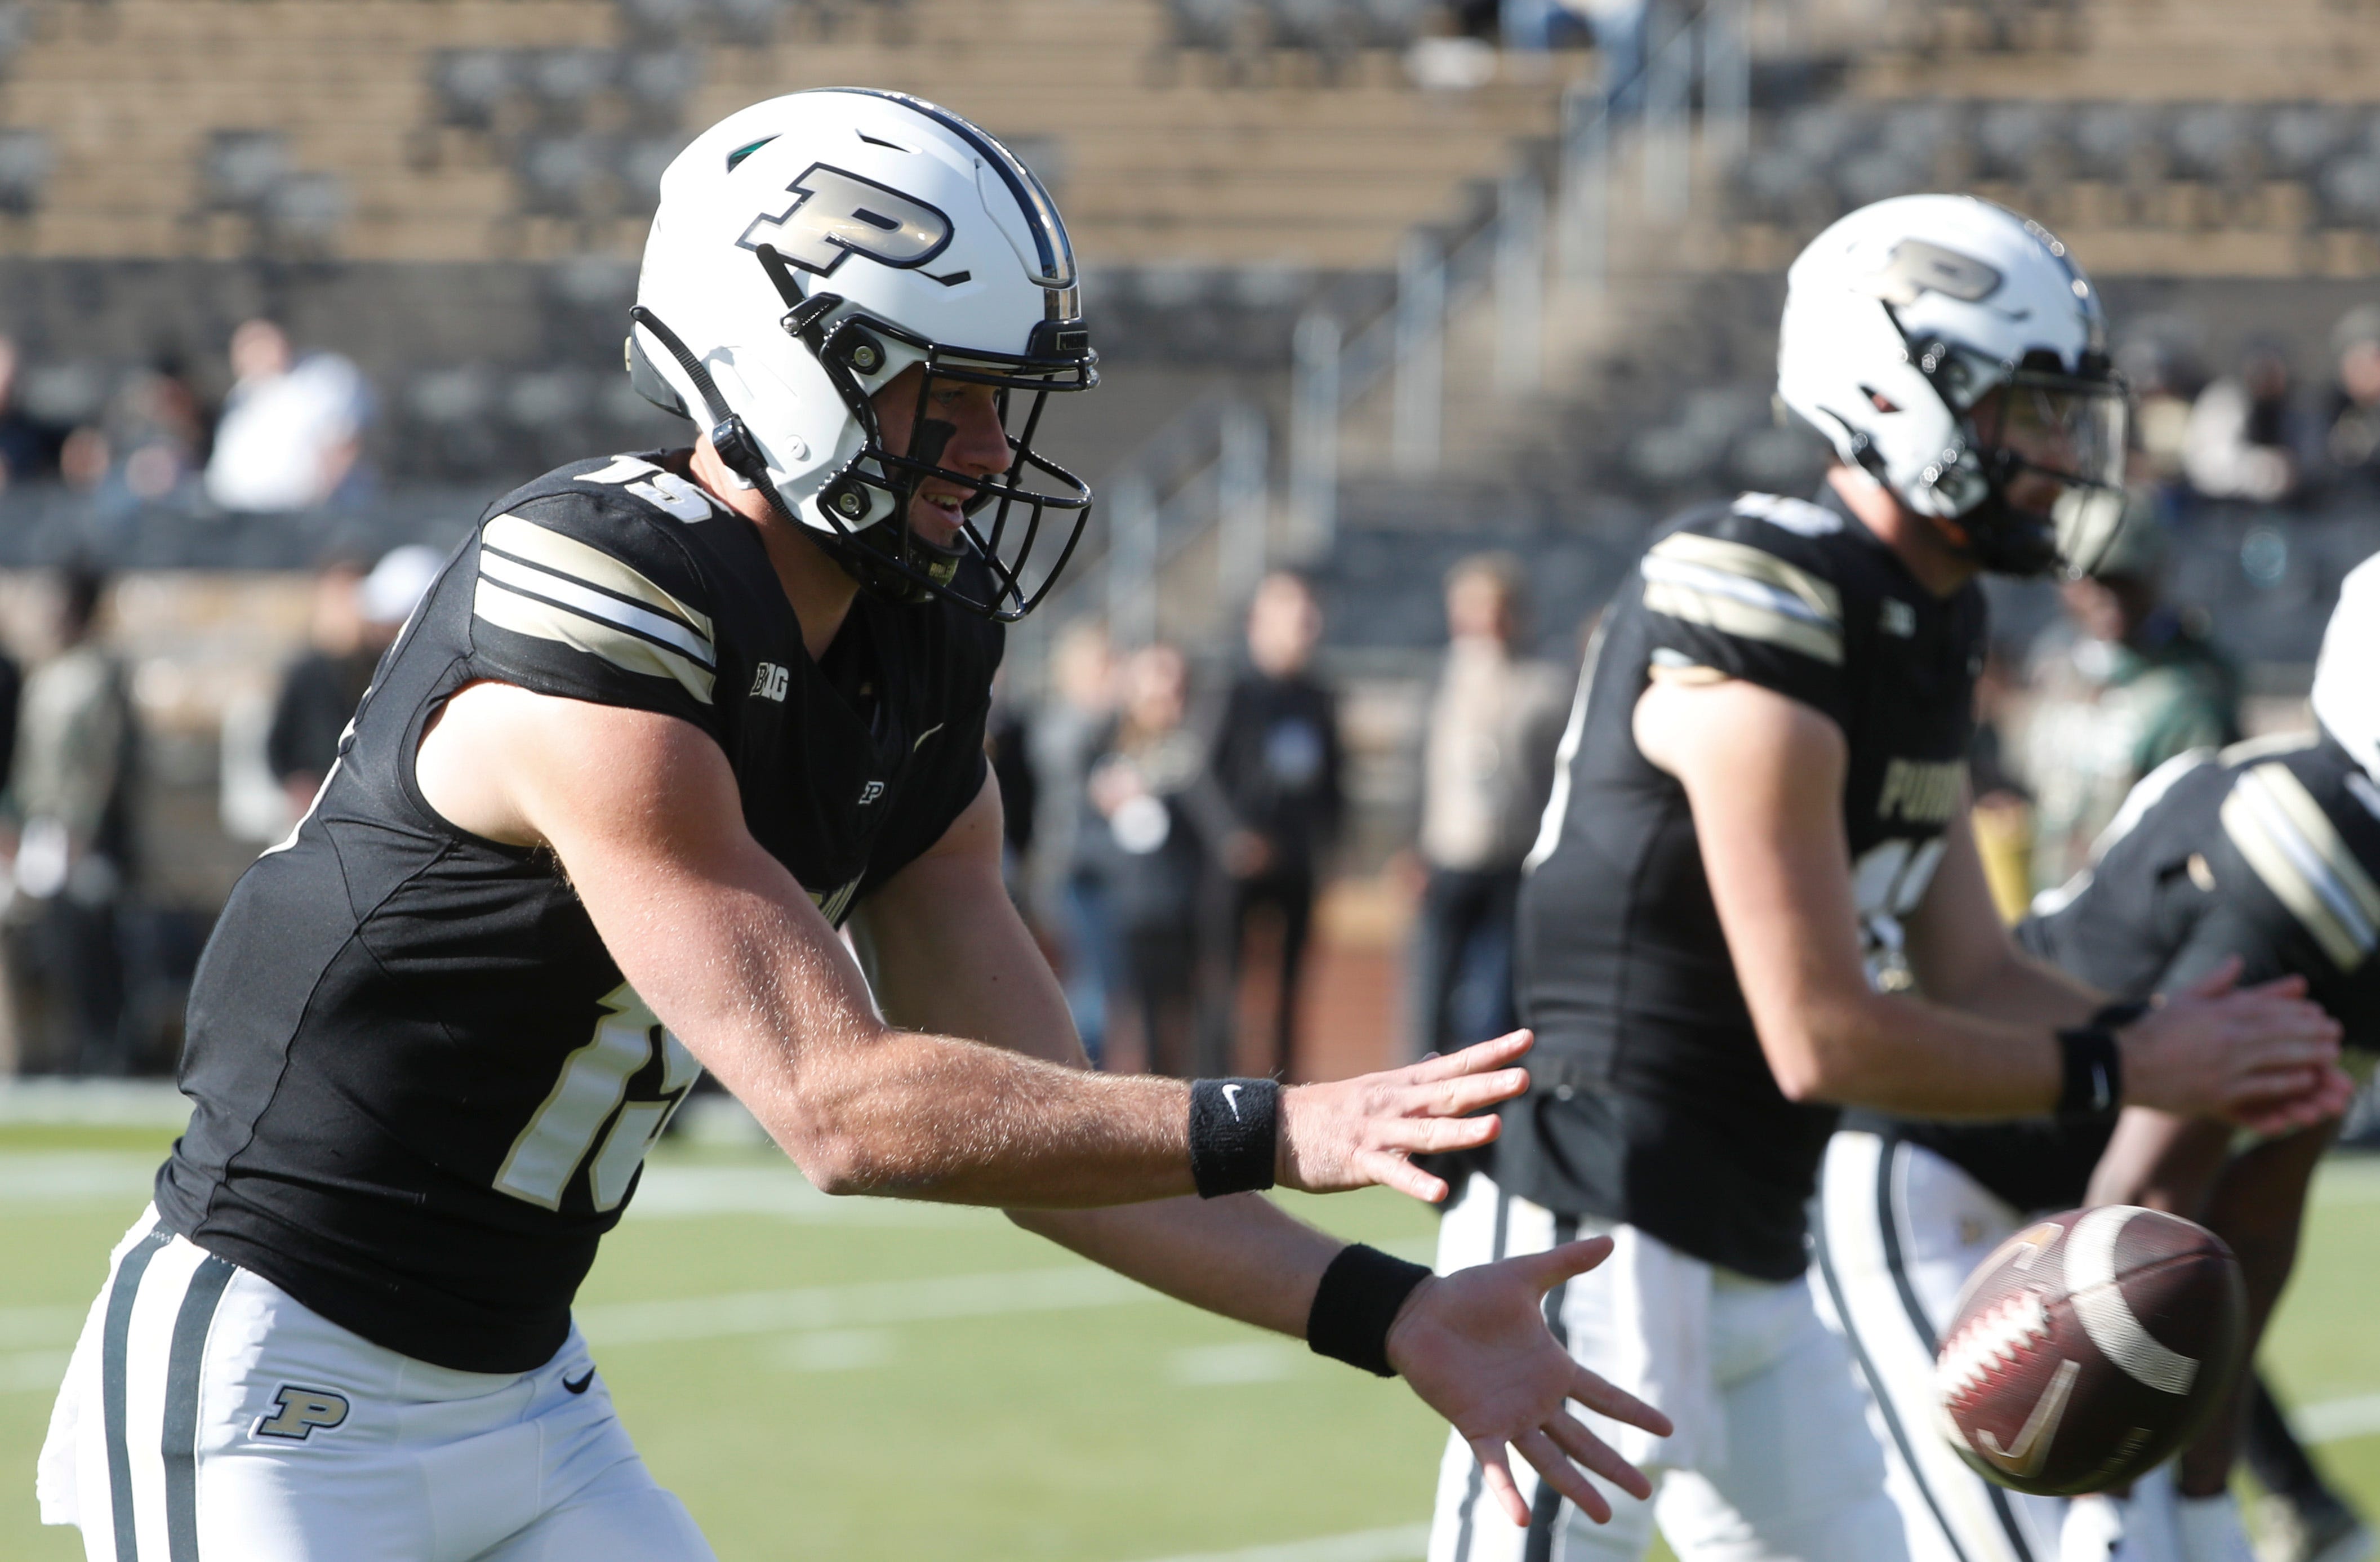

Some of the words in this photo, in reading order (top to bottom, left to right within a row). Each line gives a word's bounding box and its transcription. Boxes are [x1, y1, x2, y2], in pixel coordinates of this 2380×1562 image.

[735, 161, 955, 278] P
[858, 781, 884, 804] P
[256, 1385, 350, 1441] P
